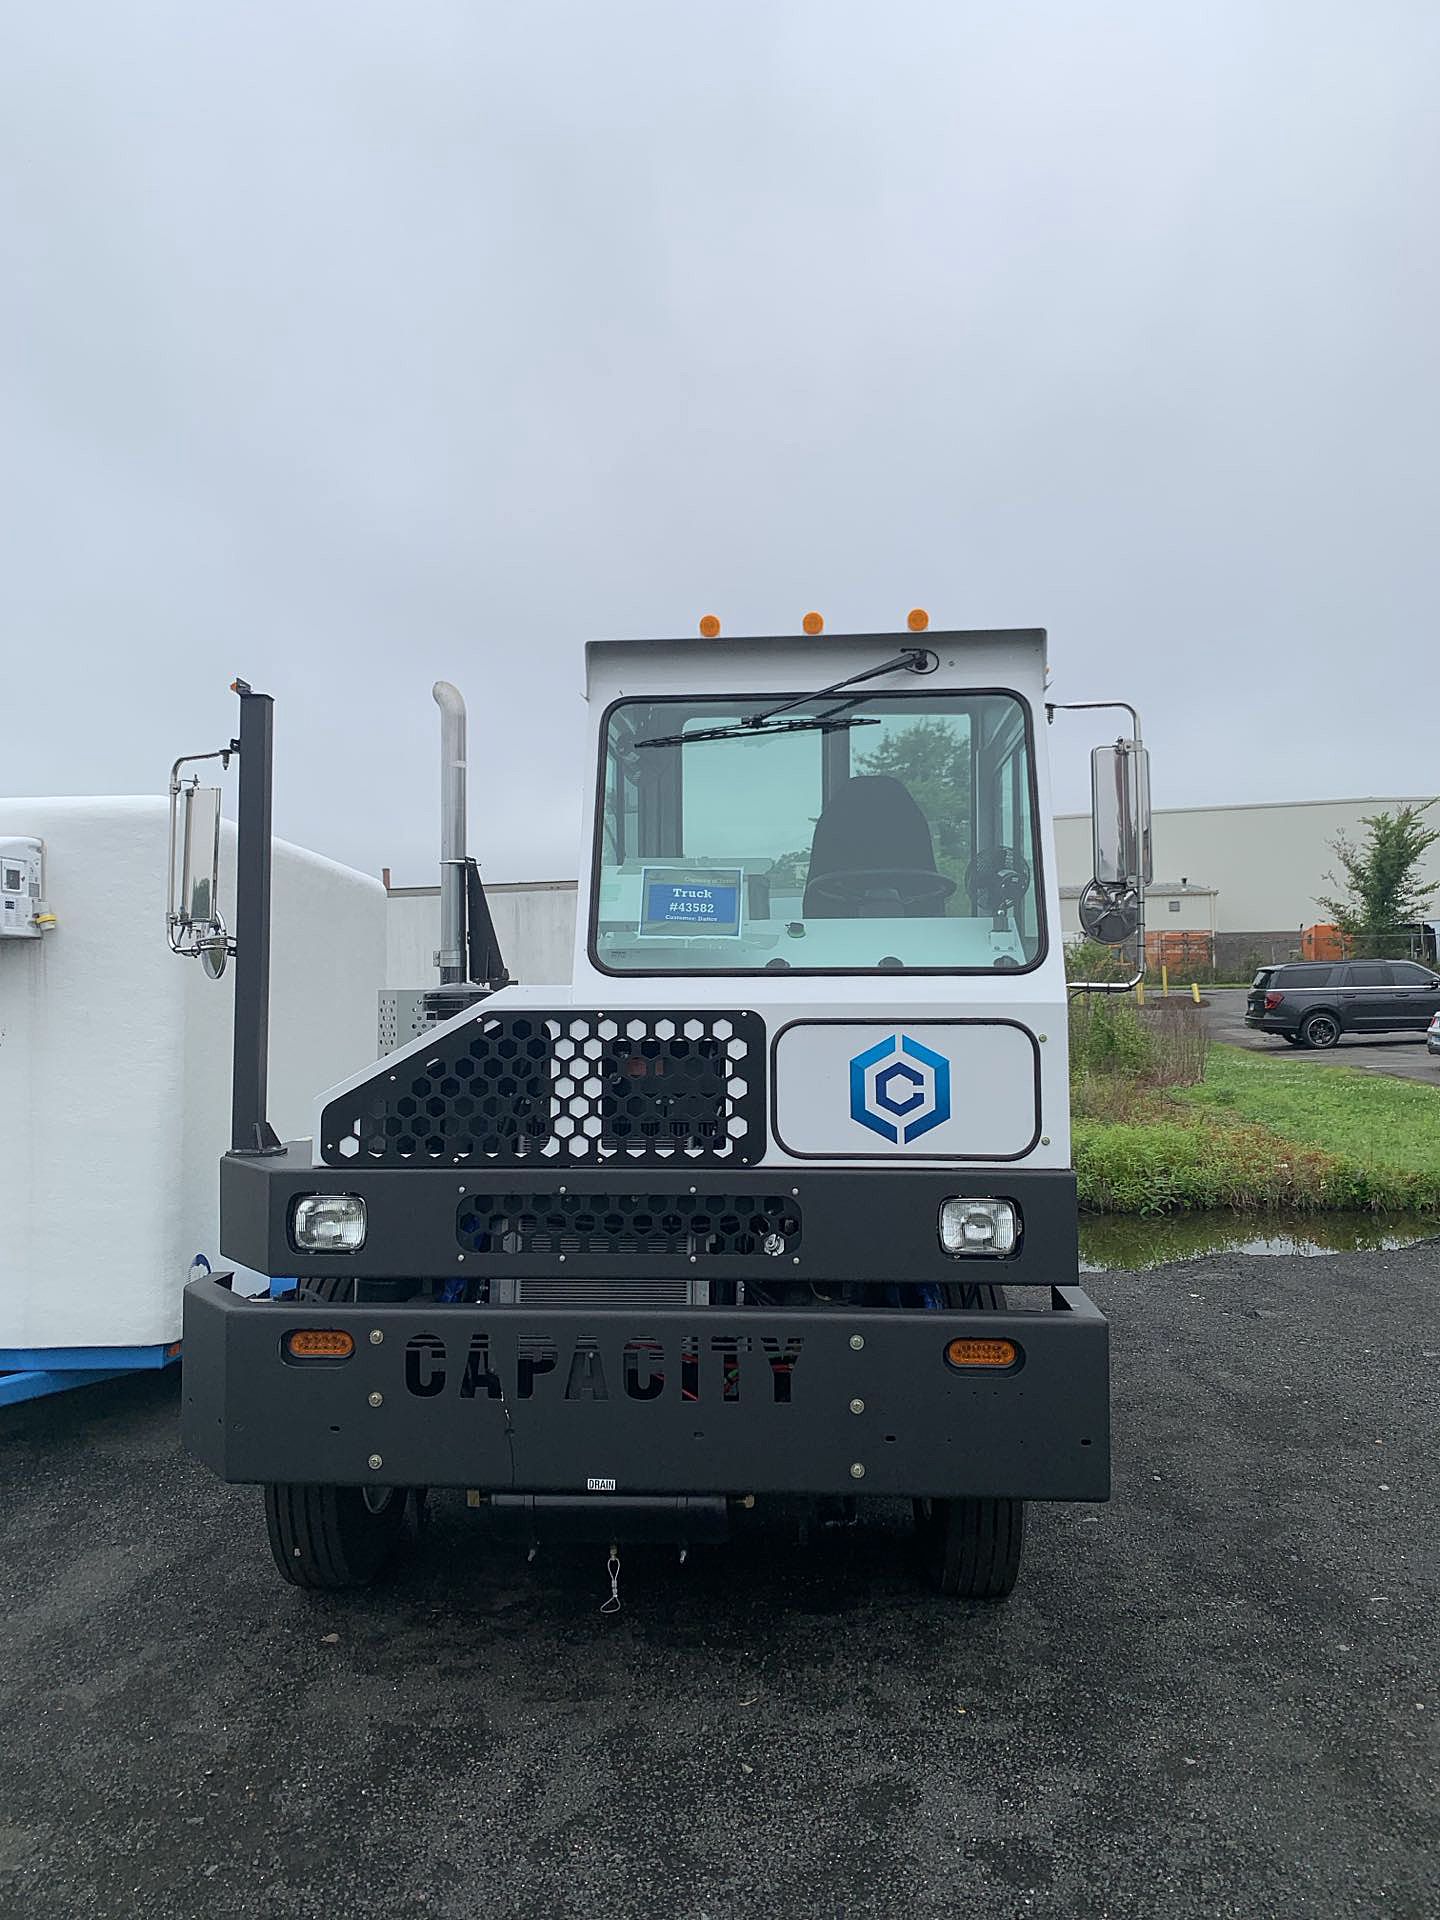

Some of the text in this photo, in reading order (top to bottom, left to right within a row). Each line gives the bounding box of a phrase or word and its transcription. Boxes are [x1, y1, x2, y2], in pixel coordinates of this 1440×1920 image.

[672, 888, 713, 898] Truck
[669, 902, 714, 913] #43582
[404, 1332, 805, 1403] CAPACITY
[588, 1479, 615, 1490] DRAIN
